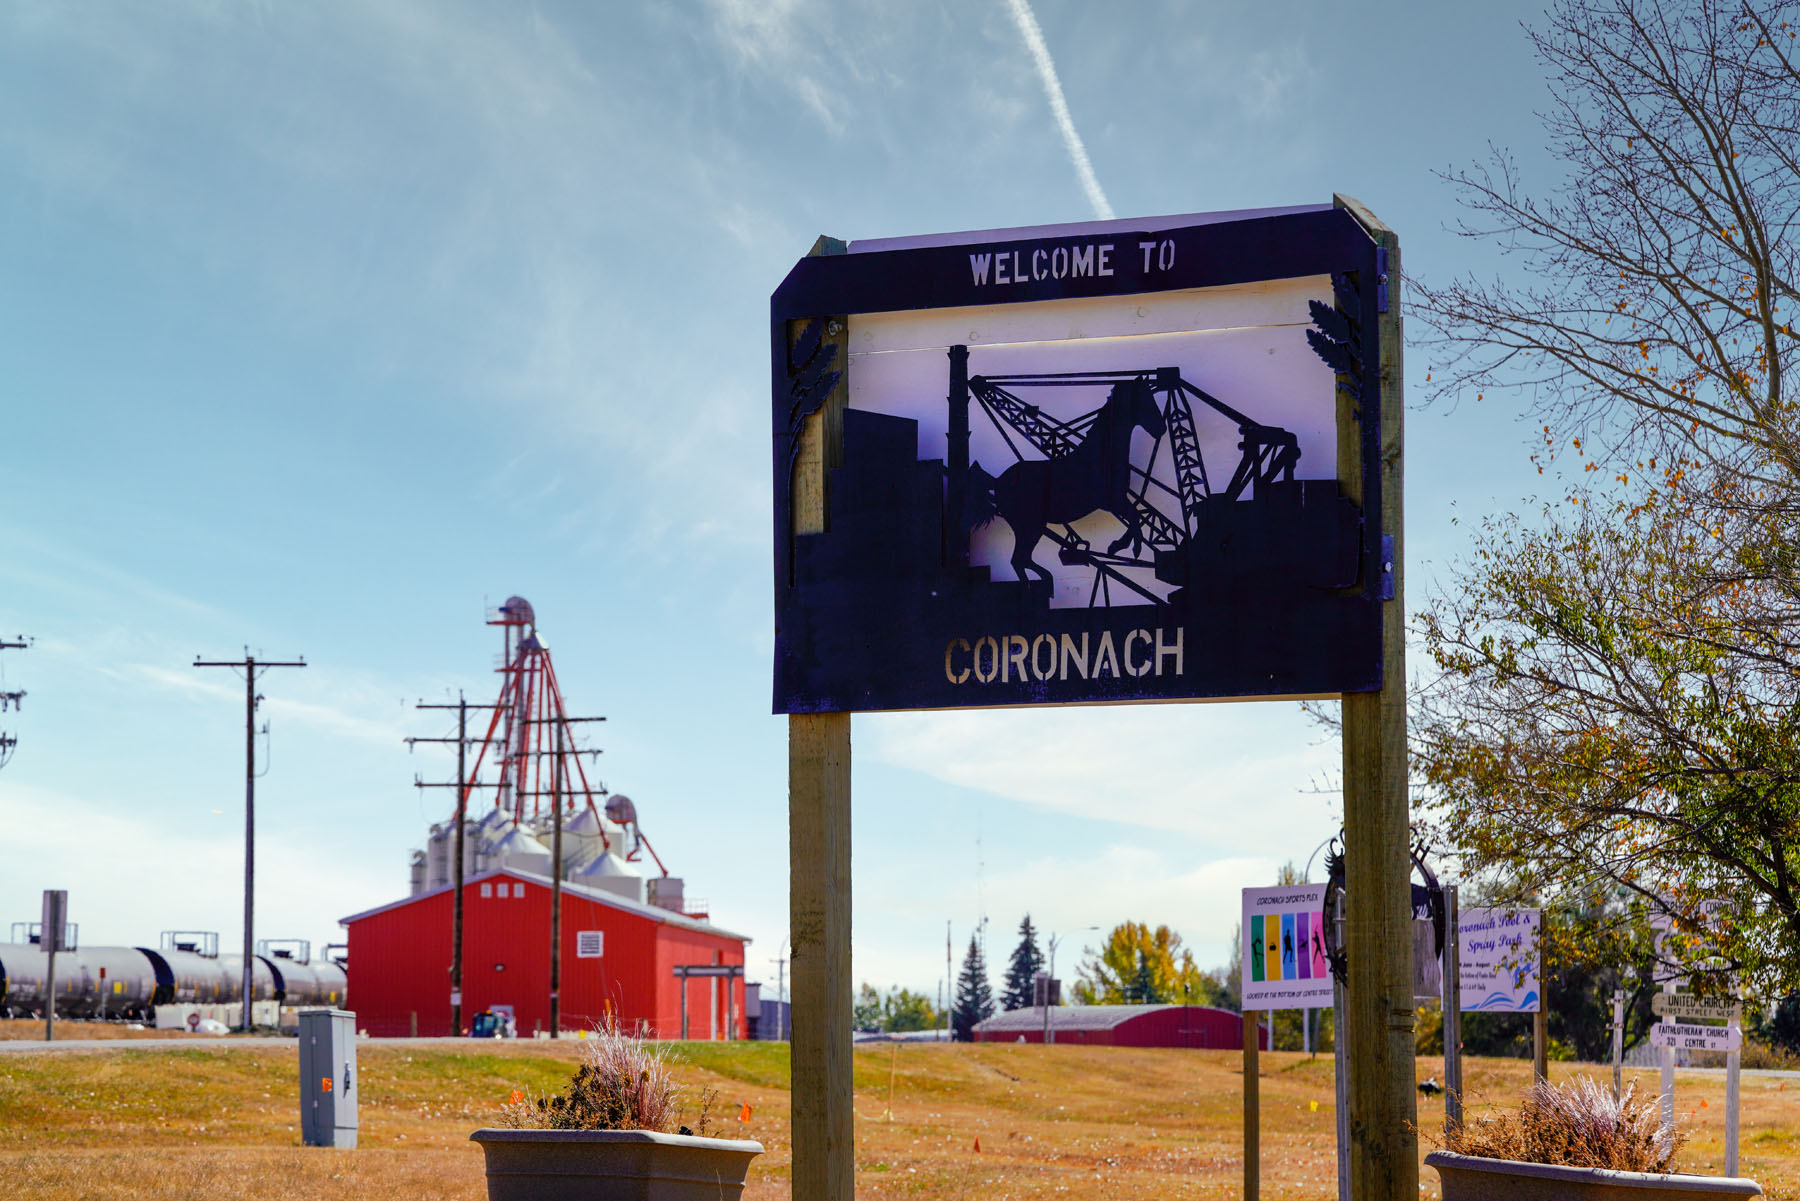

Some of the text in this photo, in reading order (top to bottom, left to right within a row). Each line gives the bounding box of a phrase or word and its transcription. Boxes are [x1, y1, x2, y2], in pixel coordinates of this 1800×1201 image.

[970, 239, 1175, 286] WELCOME TO
[945, 627, 1183, 684] CORONACH
[1256, 892, 1318, 906] CORONACH SPORTS PLEX
[1458, 912, 1531, 934] oronach Pool &
[1467, 932, 1522, 954] Spray Park
[1668, 995, 1731, 1009] UNITED CHURCH
[1706, 1027, 1729, 1040] CHURCH
[1685, 1039, 1706, 1048] CENTRE
